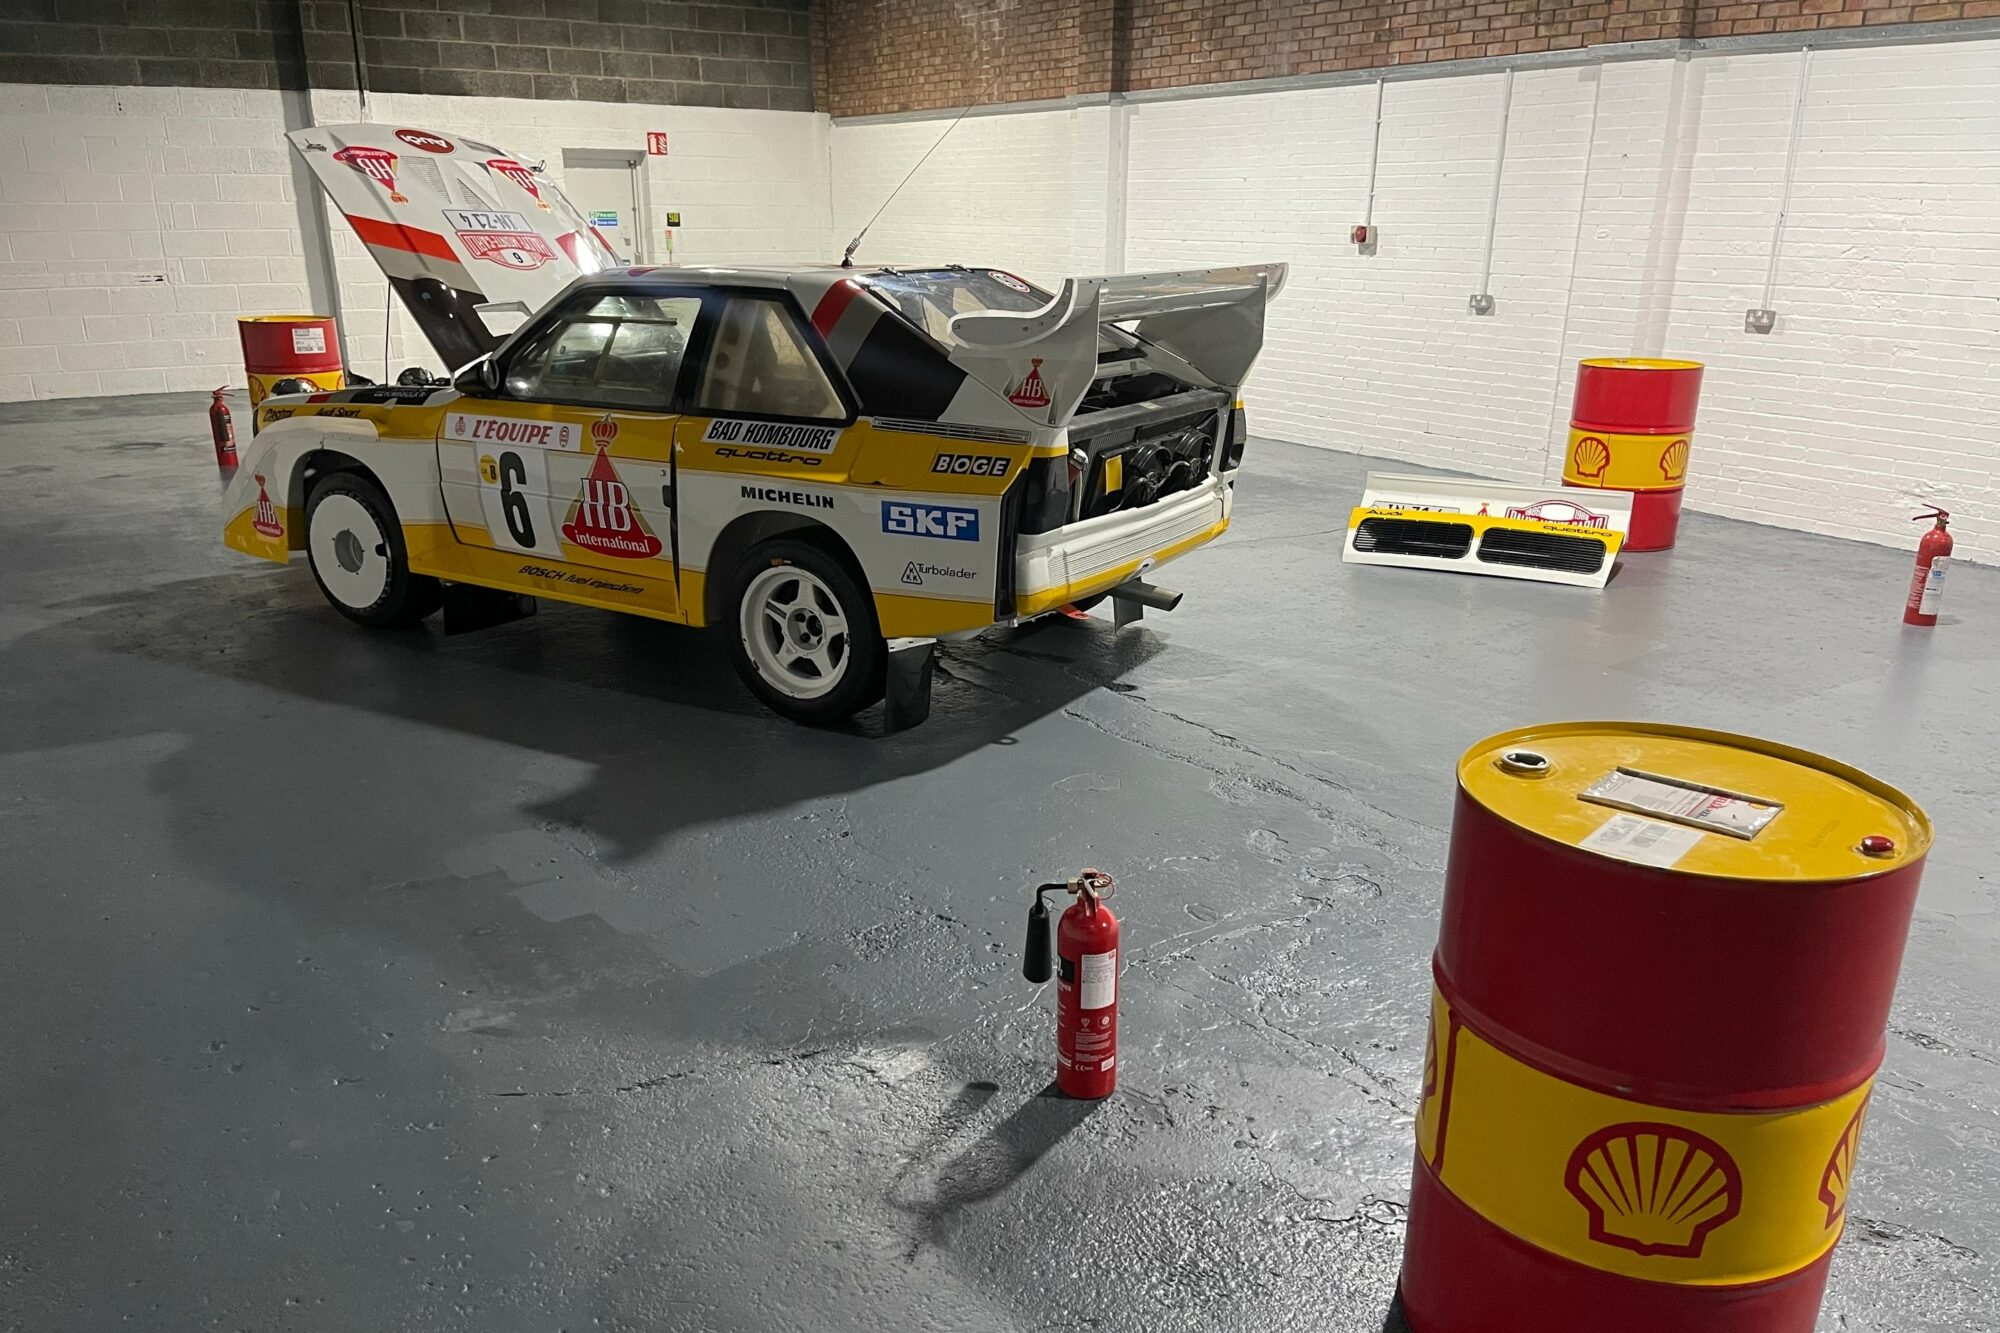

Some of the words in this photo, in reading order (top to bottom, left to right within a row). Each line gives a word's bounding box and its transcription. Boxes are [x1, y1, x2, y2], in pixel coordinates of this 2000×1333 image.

[357, 158, 398, 180] HB
[505, 170, 536, 190] HB
[513, 252, 523, 263] 6
[1020, 379, 1042, 398] HB
[472, 419, 553, 445] L'ÉQUIPE
[708, 420, 742, 441] BAD
[742, 423, 836, 450] HOMBOURG
[715, 447, 822, 466] quattro
[936, 456, 1006, 475] BOGE
[499, 451, 536, 549] 6
[582, 478, 632, 532] HB
[741, 485, 834, 509] MICHELIN
[257, 500, 276, 525] HB
[888, 505, 975, 537] SKF
[1366, 509, 1403, 517] Audi
[575, 530, 650, 553] international
[1543, 525, 1613, 538] quattro
[518, 565, 567, 580] BOSCH
[917, 562, 977, 580] Turbolader
